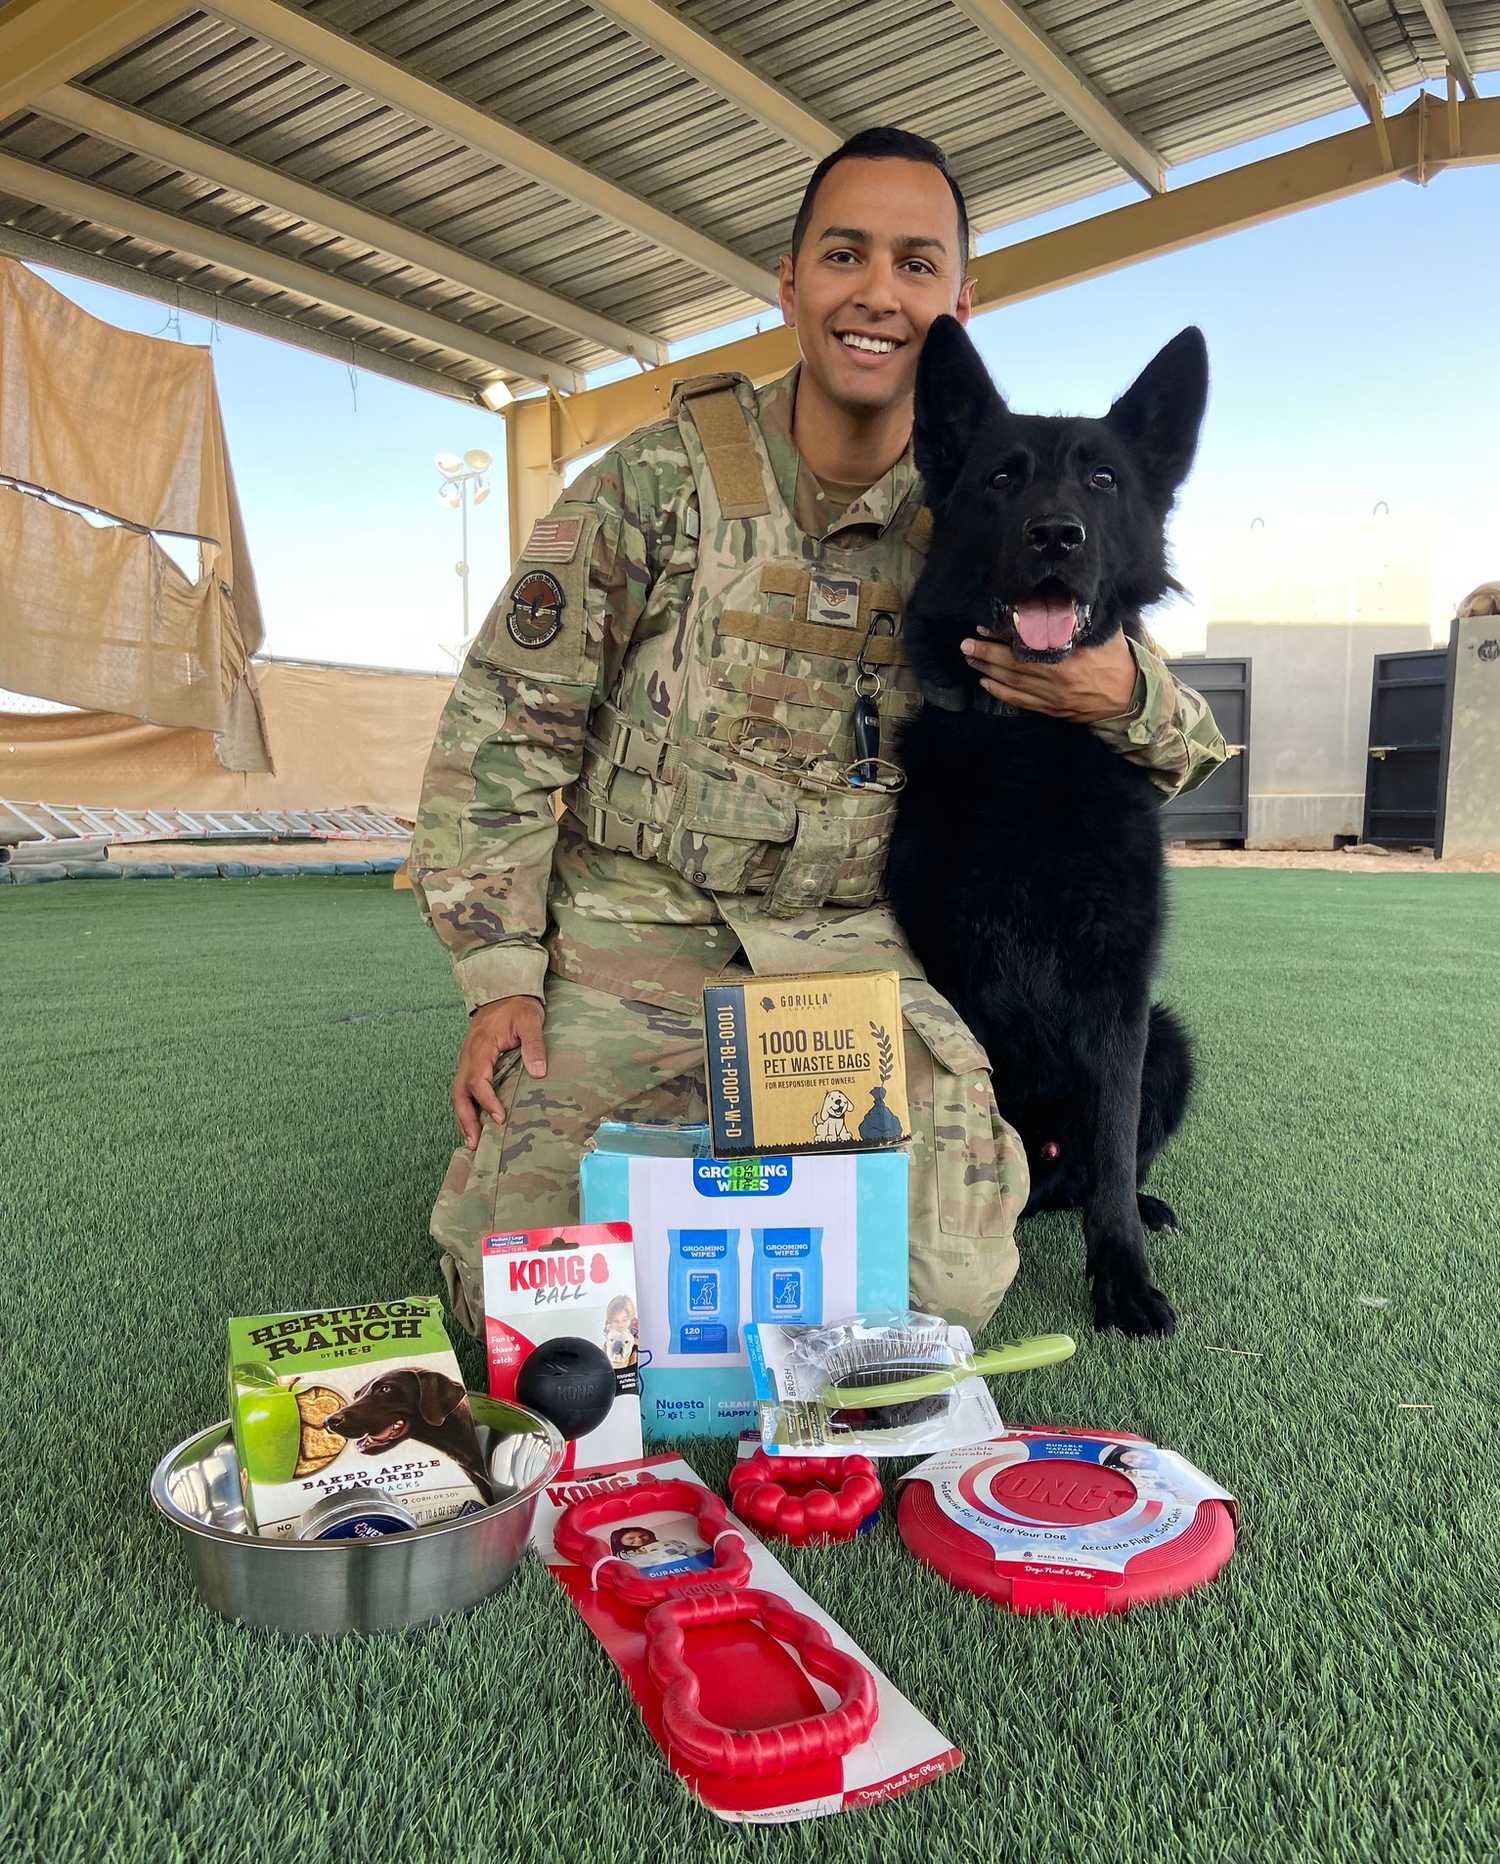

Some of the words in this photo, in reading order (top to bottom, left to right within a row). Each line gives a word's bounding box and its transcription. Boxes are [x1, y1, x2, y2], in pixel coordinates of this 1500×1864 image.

[780, 993, 828, 1008] GORILLA
[758, 1030, 807, 1056] 1000
[812, 1029, 856, 1051] BLUE
[717, 1005, 742, 1138] 1000-BL-POOP-W-D
[764, 1059, 786, 1074] PET
[791, 1056, 834, 1072] WASTE
[838, 1052, 871, 1069] BAGS
[765, 1082, 776, 1090] FOR
[778, 1079, 817, 1088] RESPONSIBLE
[818, 1078, 830, 1086] PET
[830, 1076, 856, 1086] OWNERS
[698, 1164, 788, 1178] GROOMING
[509, 1256, 585, 1291] KONG
[534, 1284, 588, 1305] BALL
[248, 1302, 430, 1346] HERITAGE
[264, 1319, 422, 1361] RANCH
[492, 1356, 512, 1364] catch
[784, 1368, 796, 1396] BRUSH
[656, 1400, 704, 1408] Nuesta
[302, 1471, 368, 1490] BAKED
[380, 1459, 440, 1475] APPLE
[324, 1470, 424, 1494] FLAVORED
[438, 1506, 446, 1516] OZ
[942, 1488, 961, 1510] Exercise
[960, 1508, 974, 1518] For
[976, 1516, 992, 1527] You
[993, 1525, 1014, 1534] And
[1017, 1530, 1041, 1538] Your
[1044, 1532, 1067, 1541] Dog
[278, 1524, 292, 1532] NO
[1081, 1542, 1129, 1550] Accurate
[1156, 1522, 1174, 1535] Soft
[1167, 1508, 1182, 1524] Catch
[650, 1566, 690, 1578] DURABLE
[1024, 1566, 1044, 1574] Dogs
[860, 1790, 884, 1799] Dogs
[884, 1776, 910, 1792] Need
